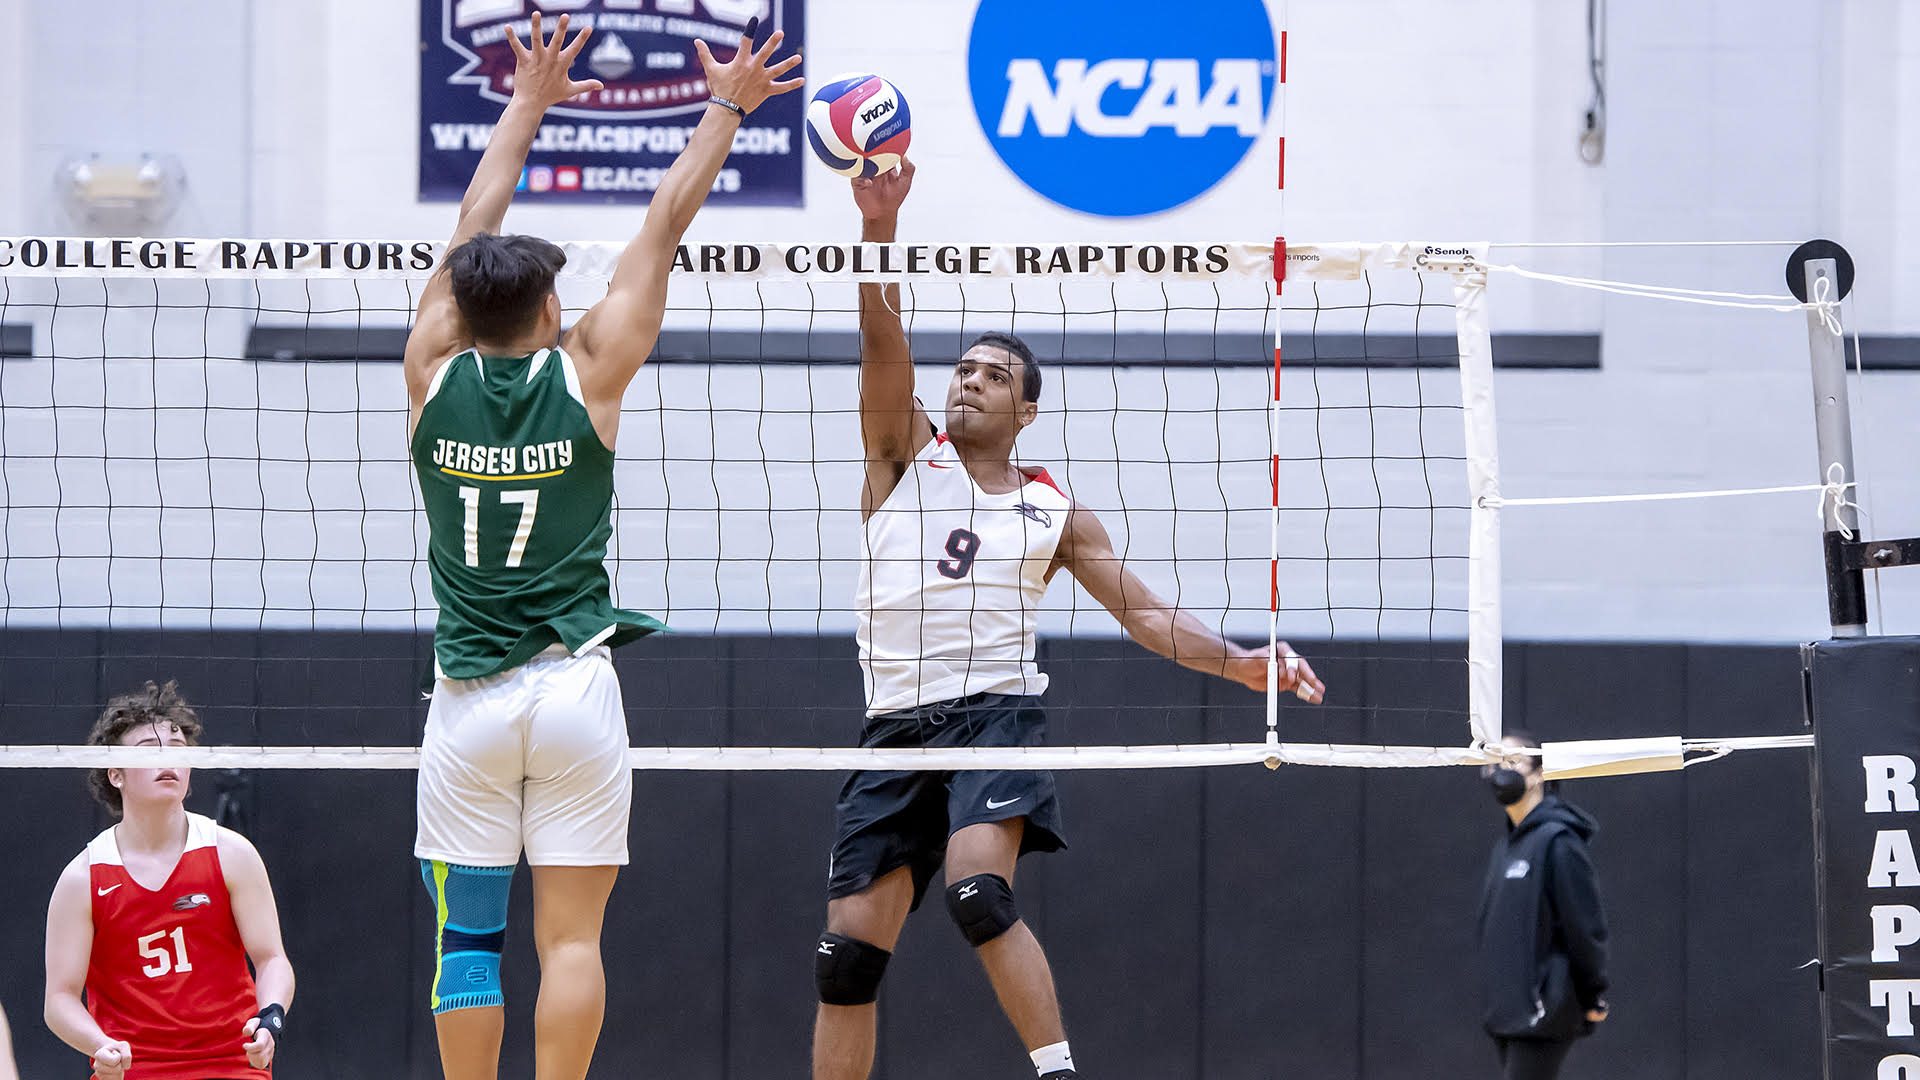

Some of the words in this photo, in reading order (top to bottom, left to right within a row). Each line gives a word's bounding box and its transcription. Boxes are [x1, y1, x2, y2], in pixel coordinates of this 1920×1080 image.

[860, 98, 895, 124] NCAA
[998, 59, 1265, 137] NCAA
[221, 241, 434, 270] RAPTORS
[669, 244, 761, 273] ARD
[784, 245, 992, 274] COLLEGE
[1015, 244, 1230, 273] RAPTORS
[1292, 254, 1320, 262] imports
[1434, 247, 1469, 255] Senoh
[432, 438, 516, 474] JERSEY
[522, 439, 573, 473] CITY
[458, 485, 540, 568] 17
[936, 527, 982, 580] 9
[138, 926, 193, 978] 51
